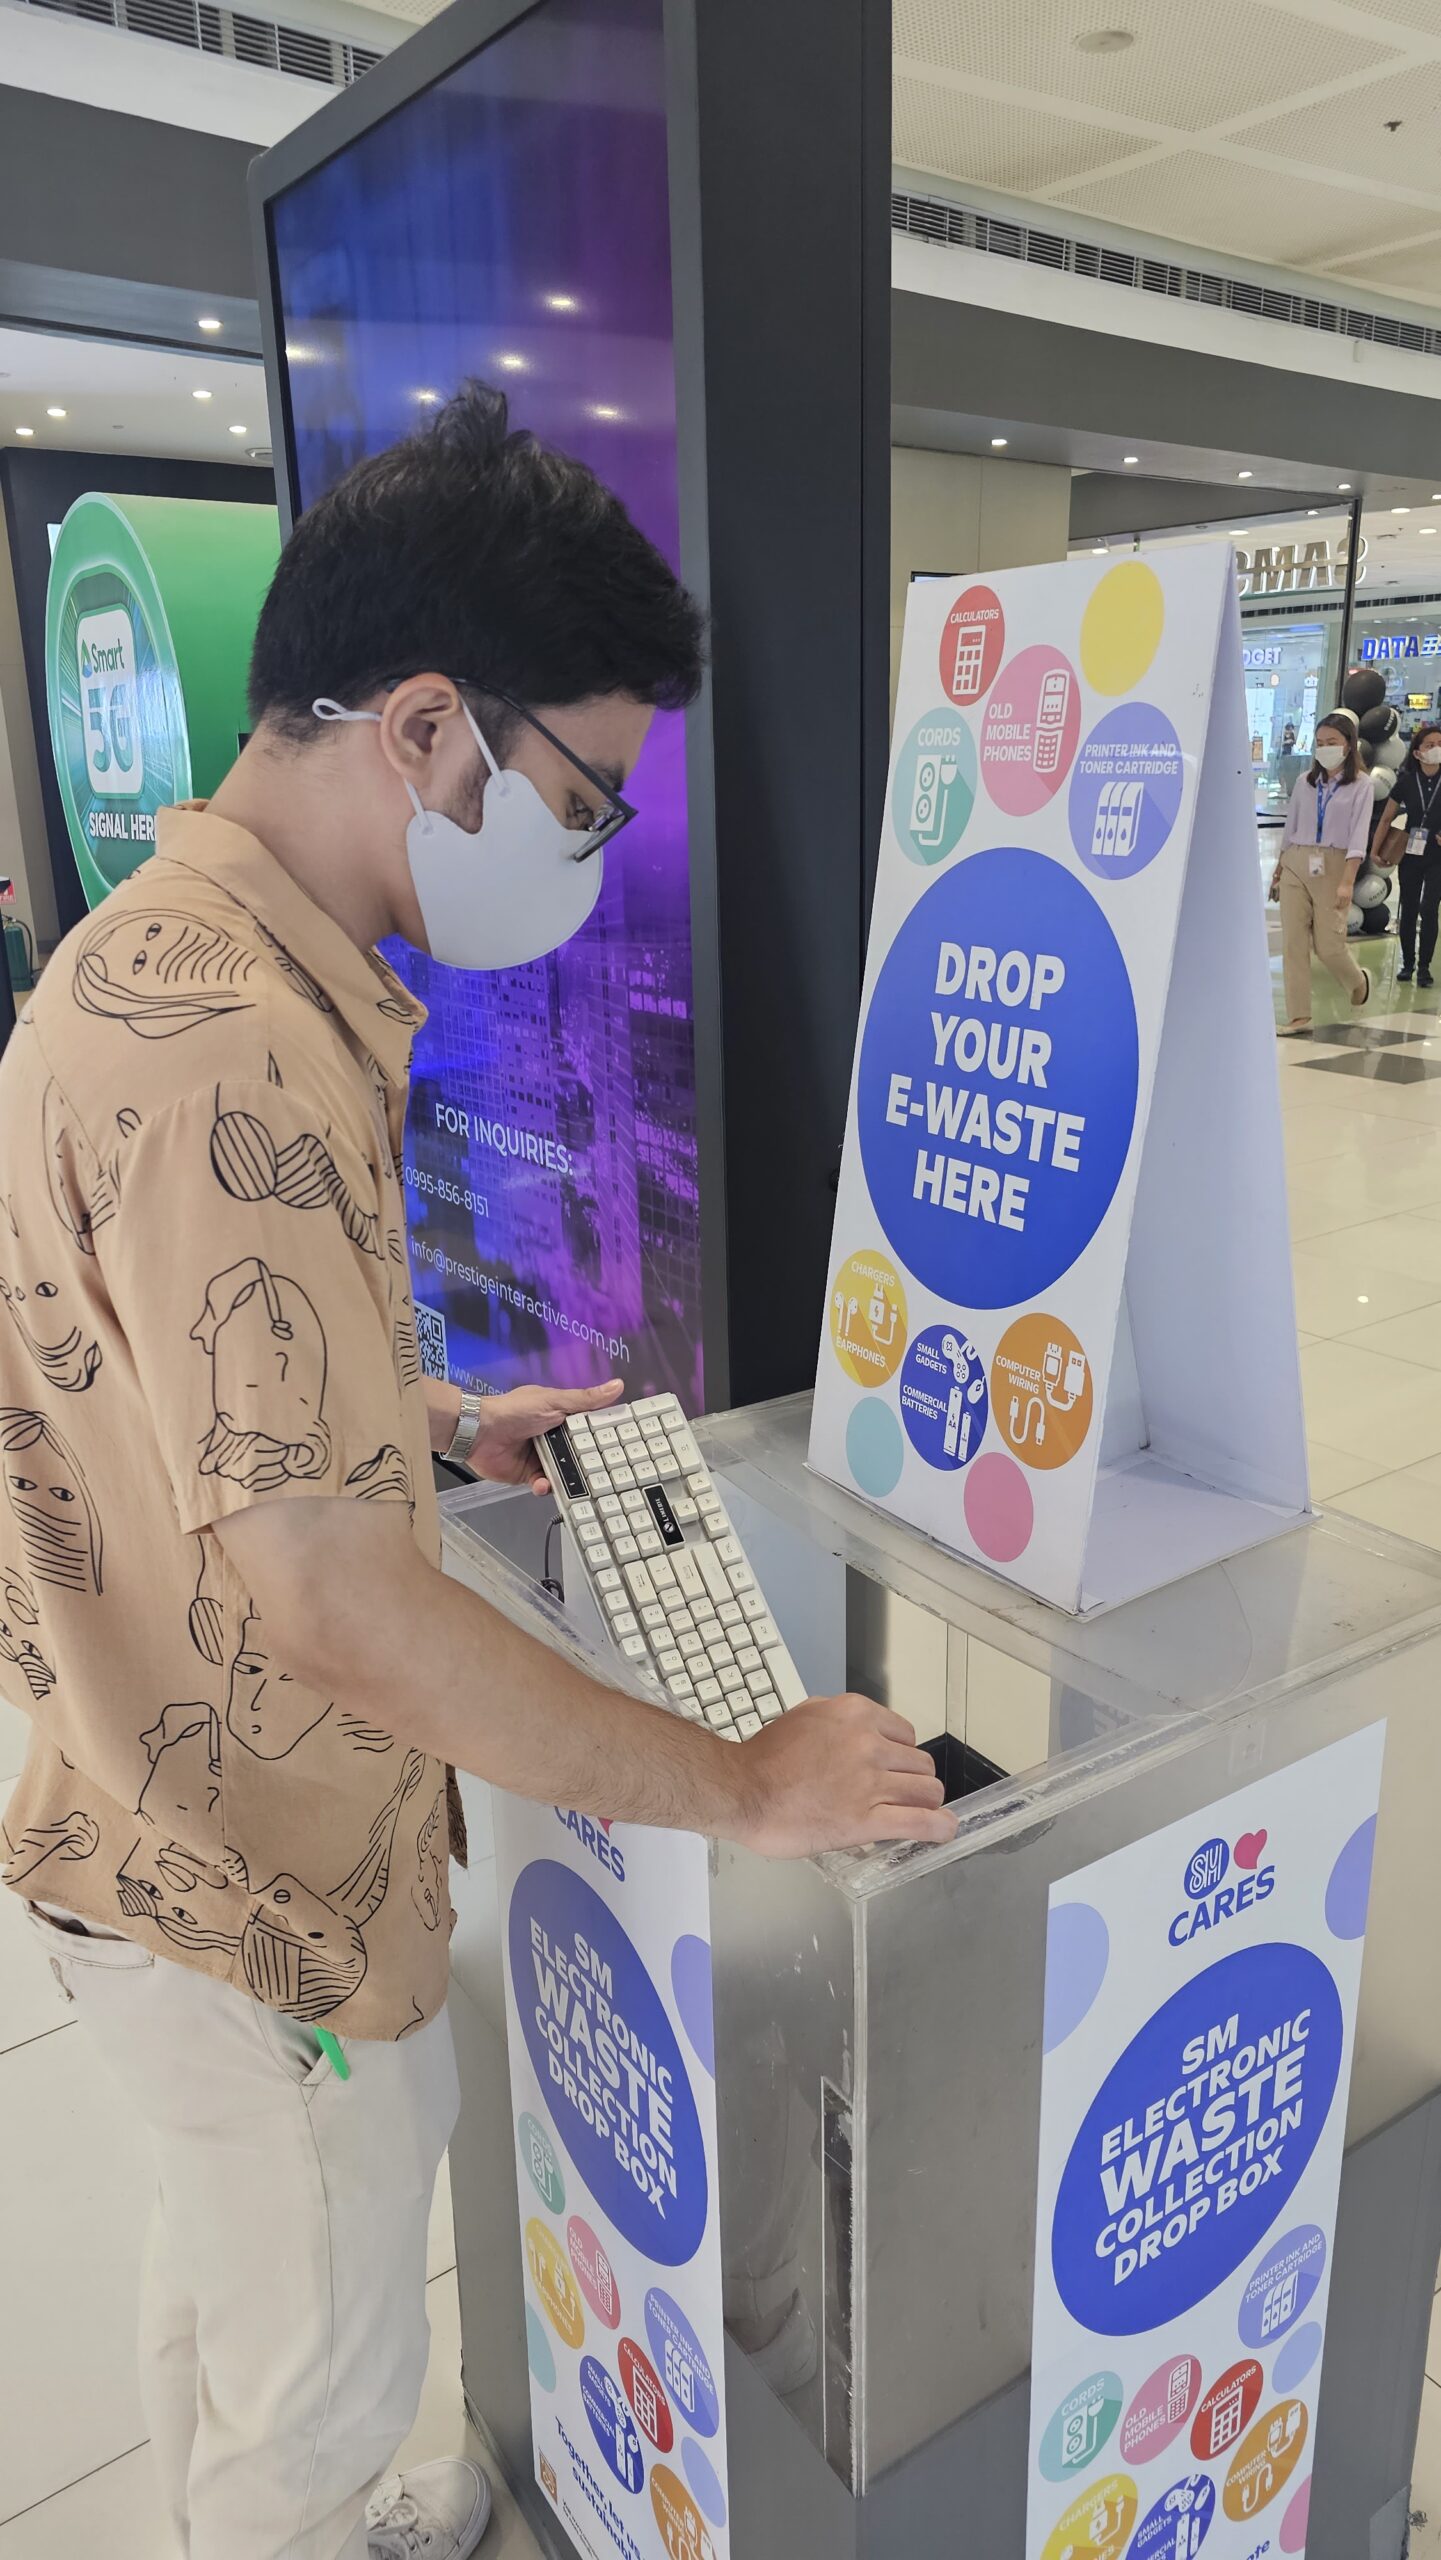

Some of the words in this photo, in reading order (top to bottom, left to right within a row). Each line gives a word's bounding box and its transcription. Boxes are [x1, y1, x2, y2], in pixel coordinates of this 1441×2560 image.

[949, 608, 1000, 624] CALCULATORS
[91, 638, 125, 673] Smart
[88, 684, 134, 773] 5G
[989, 703, 1013, 720] OLD
[917, 727, 961, 747] CORDS
[986, 723, 1032, 741] MOBILE
[1084, 744, 1128, 757] PRINTER
[1129, 744, 1149, 757] INK
[1150, 743, 1176, 757] AND
[983, 745, 1032, 762] PHONES
[1079, 760, 1114, 775] TONER
[1115, 760, 1179, 775] CARTRIDGE
[89, 811, 128, 841] SIGNAL
[934, 941, 1066, 1011] DROP
[930, 1011, 1052, 1088] YOUR
[435, 1102, 470, 1139] FOR
[474, 1115, 575, 1176] INQUIRIES:
[885, 1073, 1086, 1172] E-WASTE
[404, 1166, 489, 1218] 0995-856-8151
[913, 1149, 1031, 1232] HERE
[851, 1260, 896, 1288] CHARGERS
[410, 1234, 631, 1364] info@prestigeinteractive.com.ph
[835, 1336, 887, 1368] EARPHONES
[915, 1354, 948, 1375] GADGETS
[916, 1341, 941, 1361] SMALL
[995, 1355, 1041, 1383] COMPUTER
[902, 1384, 948, 1413] COMMERCIAL
[1008, 1374, 1040, 1395] WIRING
[901, 1397, 938, 1420] BATTERIES
[1168, 1865, 1276, 1947] CARES
[574, 1932, 613, 2000] SM
[530, 1916, 673, 2104] ELECTRONIC
[531, 1948, 674, 2160] WASTE
[1181, 2013, 1239, 2076] SM
[535, 2004, 678, 2200] COLLECTION
[1101, 2008, 1311, 2167] ELECTRONIC
[548, 2049, 610, 2139] DROP
[614, 2131, 667, 2220] BOX
[1099, 2044, 1305, 2217] WASTE
[1095, 2099, 1303, 2258] COLLECTION
[1113, 2199, 1210, 2287] DROP
[1216, 2144, 1284, 2216] BOX
[1245, 2275, 1275, 2303] TONER
[1275, 2240, 1323, 2281] CARTRIDGE
[1249, 2259, 1286, 2292] PRINTER
[1285, 2247, 1301, 2267] INK
[1301, 2233, 1321, 2253] AND
[1060, 2377, 1106, 2417] CORDS
[1201, 2365, 1257, 2413] CALCULATORS
[1124, 2404, 1165, 2442] MOBILE
[1124, 2416, 1167, 2453] PHONES
[1125, 2406, 1148, 2429] OLD
[555, 2415, 607, 2510] Together,
[608, 2499, 625, 2535] let
[1226, 2450, 1266, 2488] COMPUTER
[1137, 2514, 1164, 2540] SMALL
[1137, 2515, 1173, 2549] GADGETS
